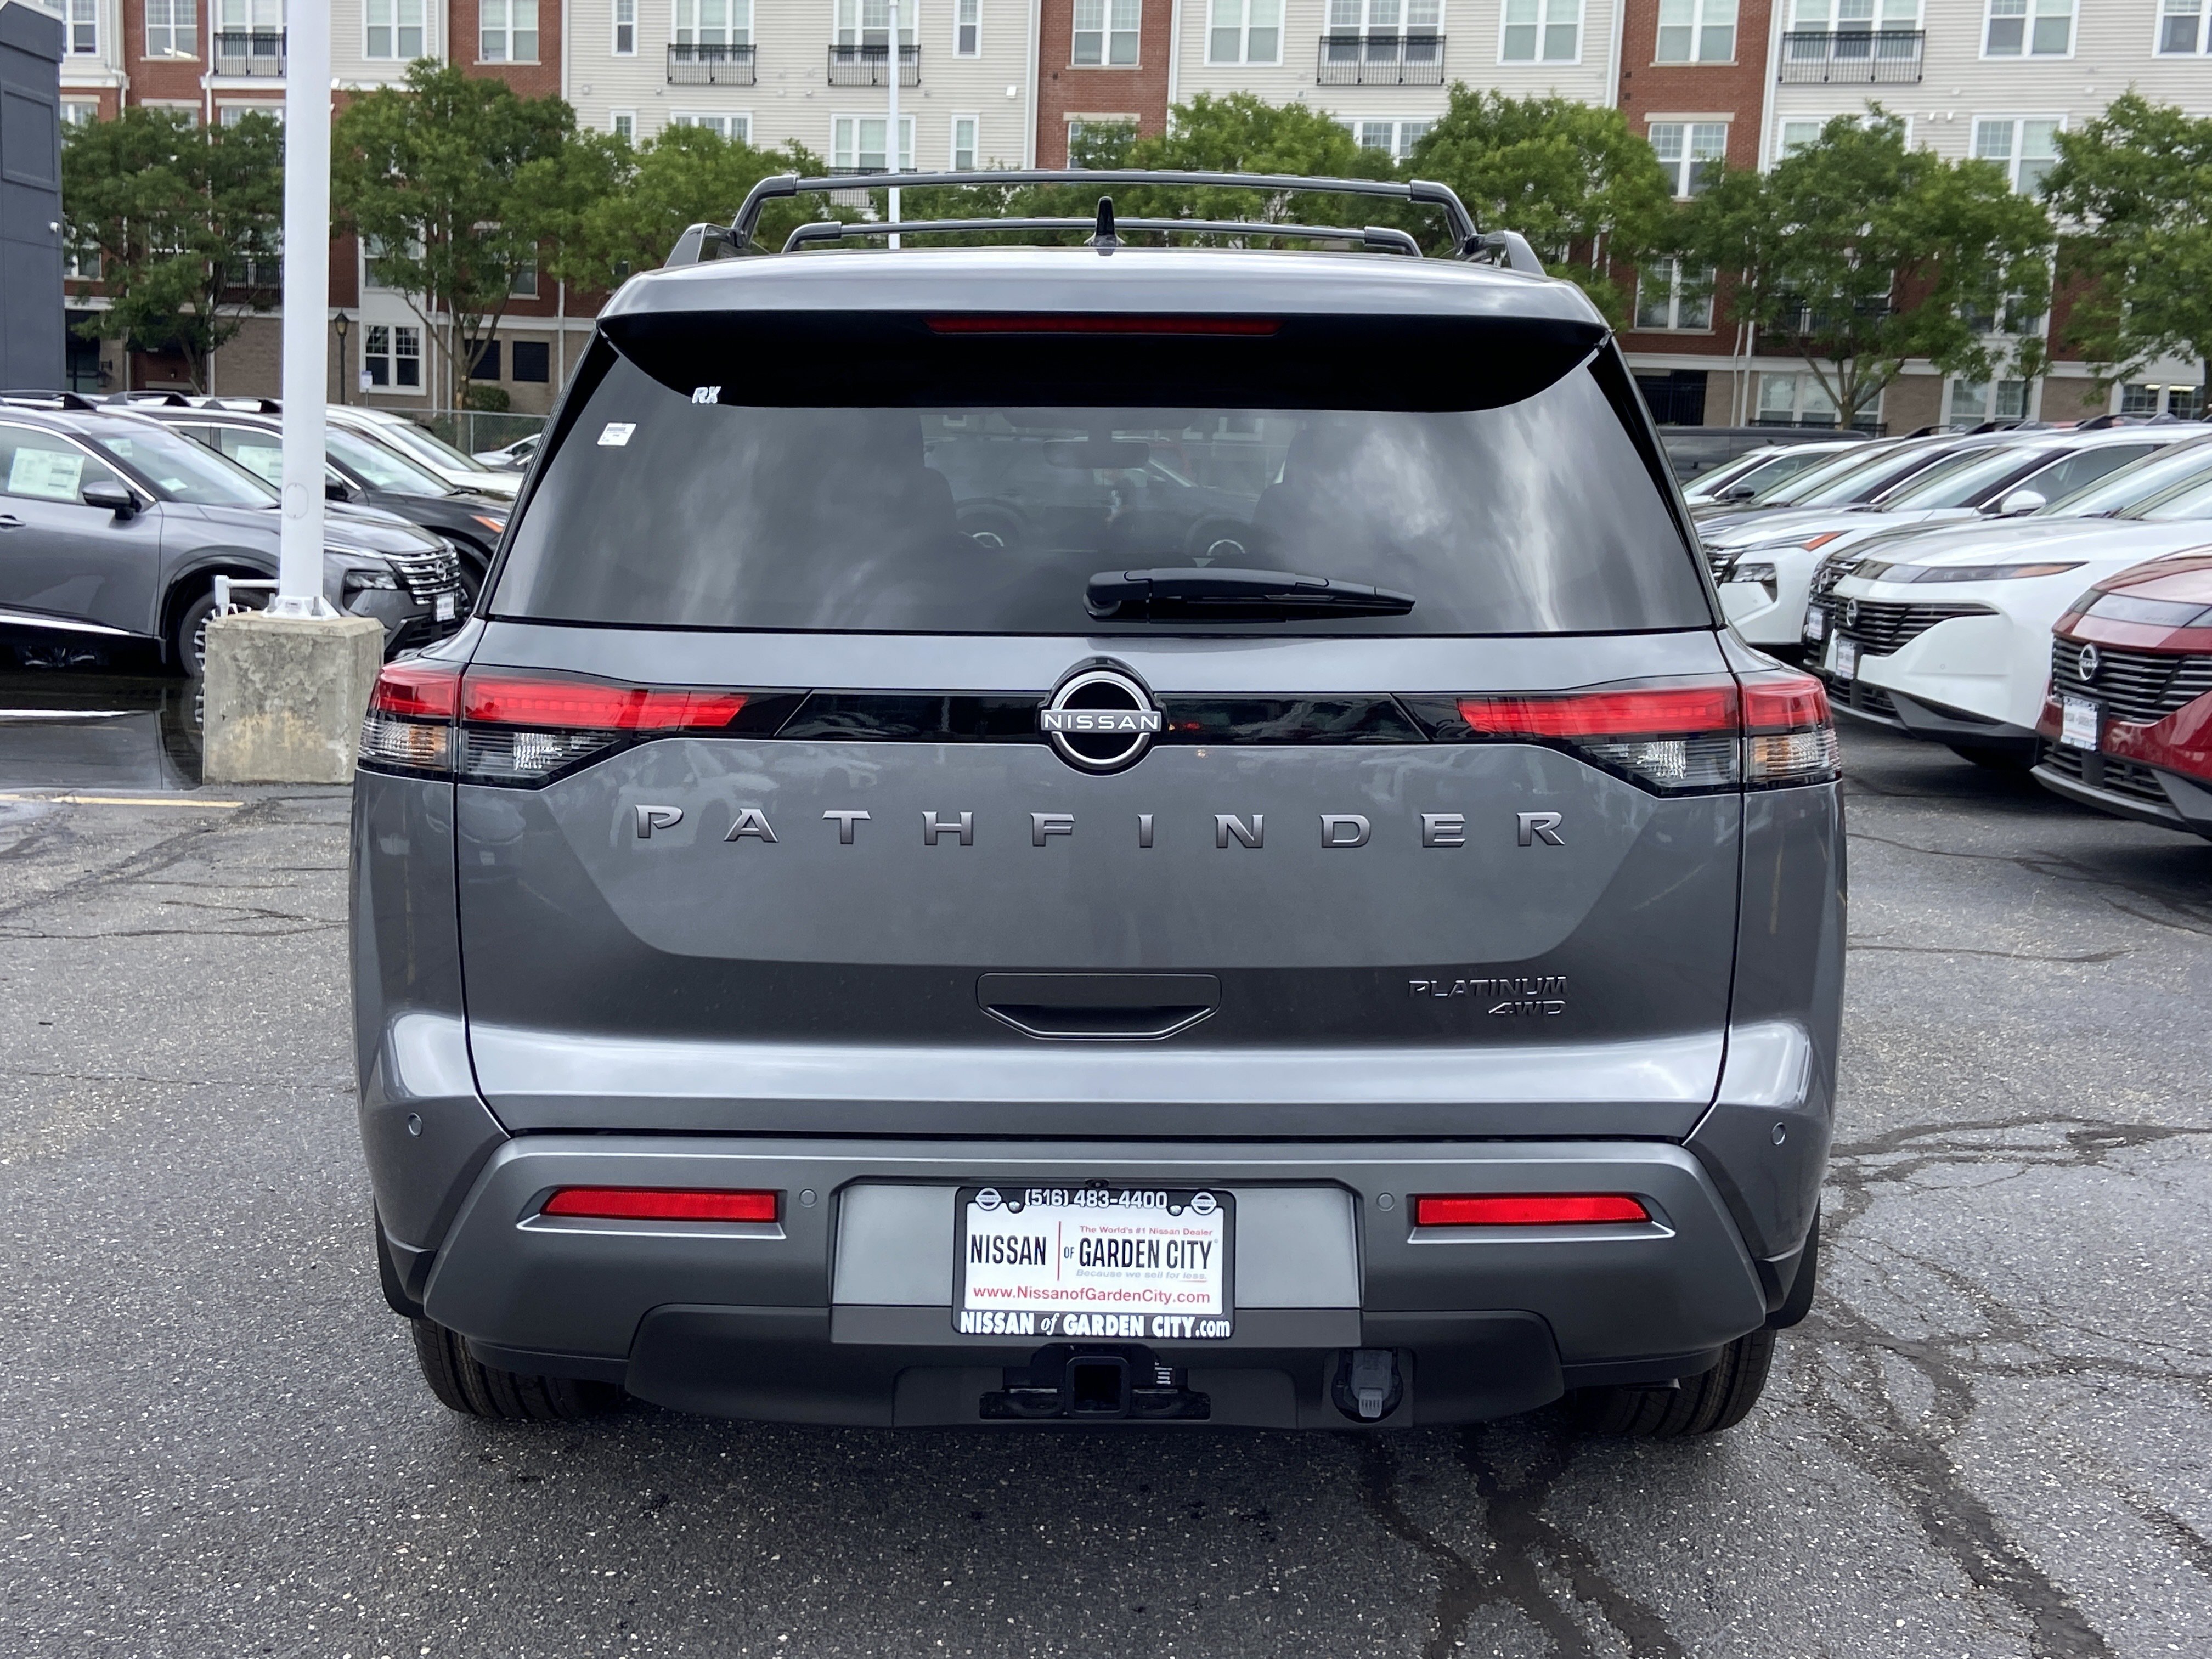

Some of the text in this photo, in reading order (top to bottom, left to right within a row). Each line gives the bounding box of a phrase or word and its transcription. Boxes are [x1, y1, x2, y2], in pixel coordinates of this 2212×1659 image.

[1044, 714, 1158, 730] NISSAN
[635, 804, 1566, 848] PATHFINDER
[1408, 975, 1567, 998] PLATINUM
[1488, 1000, 1566, 1016] 4WD
[1024, 1189, 1168, 1209] (516) 483-4400
[1080, 1225, 1097, 1234] The
[1099, 1226, 1133, 1234] World's
[1149, 1227, 1180, 1235] Nissan
[1183, 1228, 1214, 1236] Dealer
[970, 1234, 1213, 1270] NISSAN OF GARDEN CITY
[1076, 1268, 1122, 1278] Because
[1166, 1271, 1181, 1280] for
[973, 1285, 1211, 1305] www.NissanofGardenCity.com
[960, 1311, 1231, 1339] NISSAN of GARDEN CITY.com
